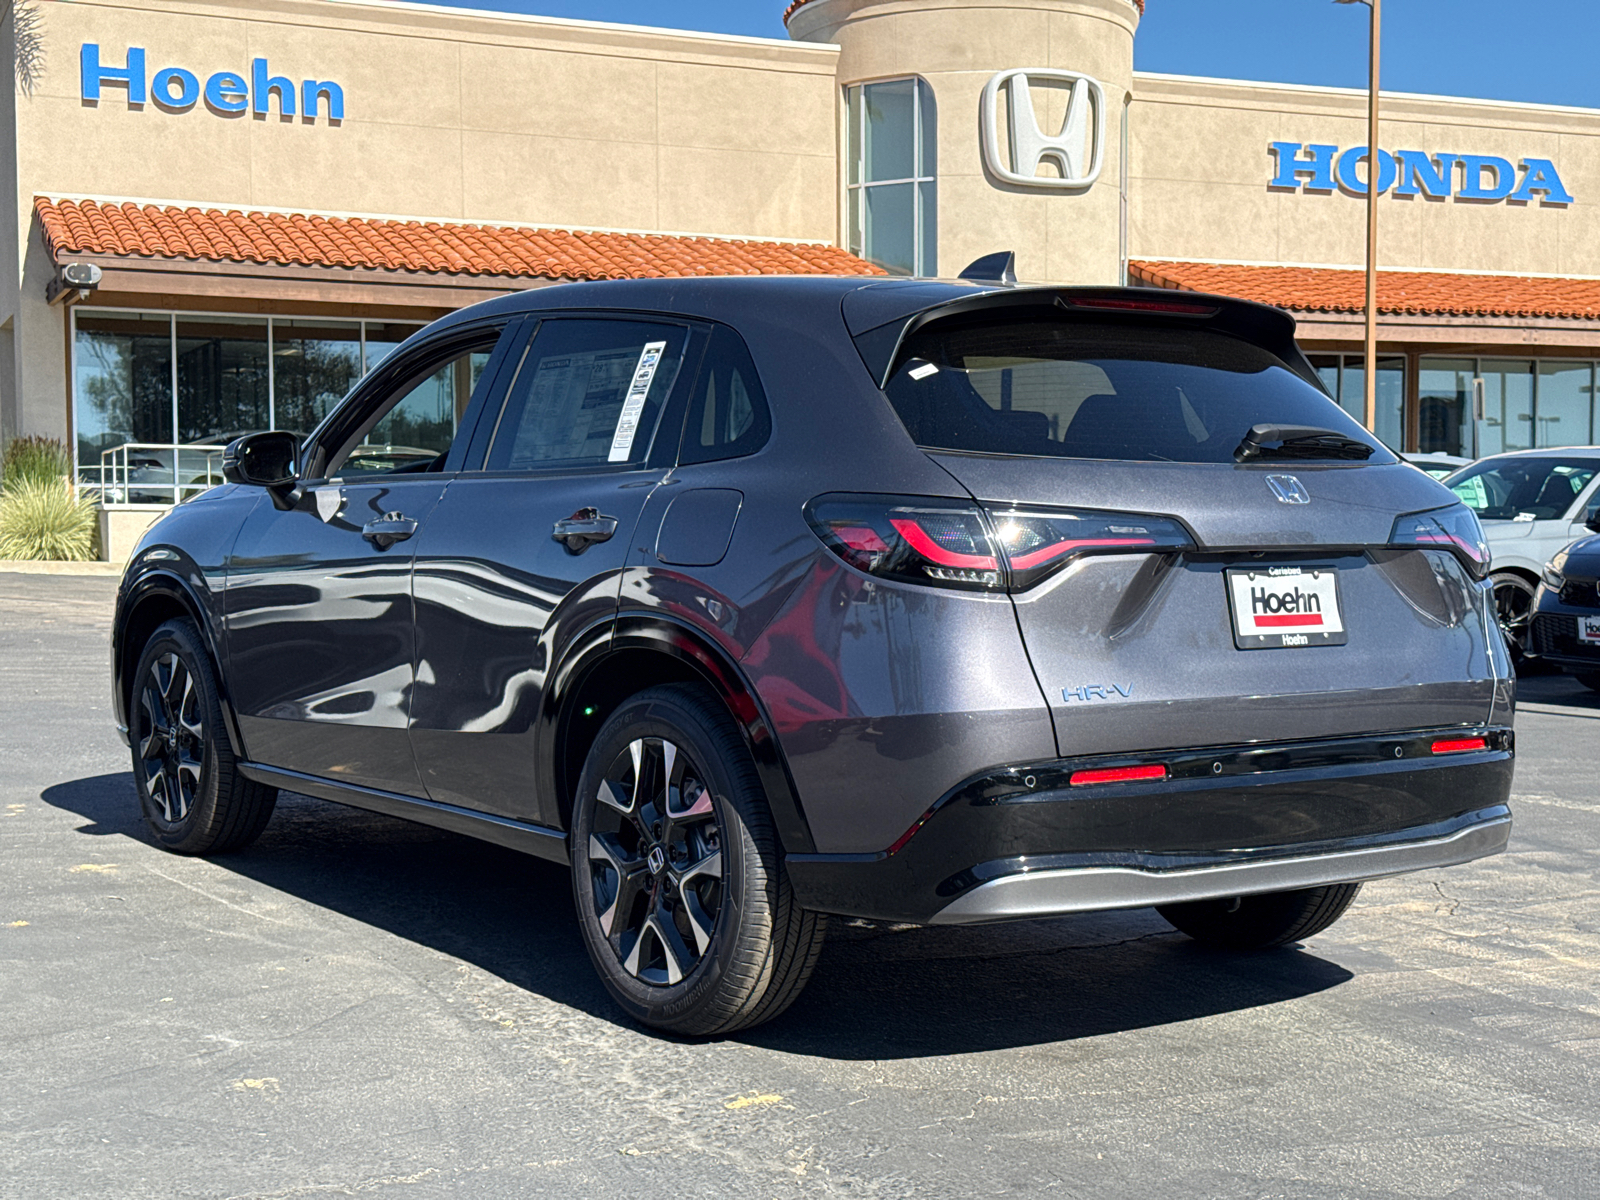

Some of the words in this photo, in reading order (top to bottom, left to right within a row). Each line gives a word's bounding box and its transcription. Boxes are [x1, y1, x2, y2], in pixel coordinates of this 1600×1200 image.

[81, 43, 344, 121] Hoehn
[1267, 141, 1575, 205] HONDA
[1268, 566, 1302, 577] Carlsbad
[1250, 586, 1322, 615] Hoehn
[1281, 633, 1309, 646] Hoehn
[1061, 681, 1134, 702] HR-V
[662, 981, 705, 1017] Hankook
